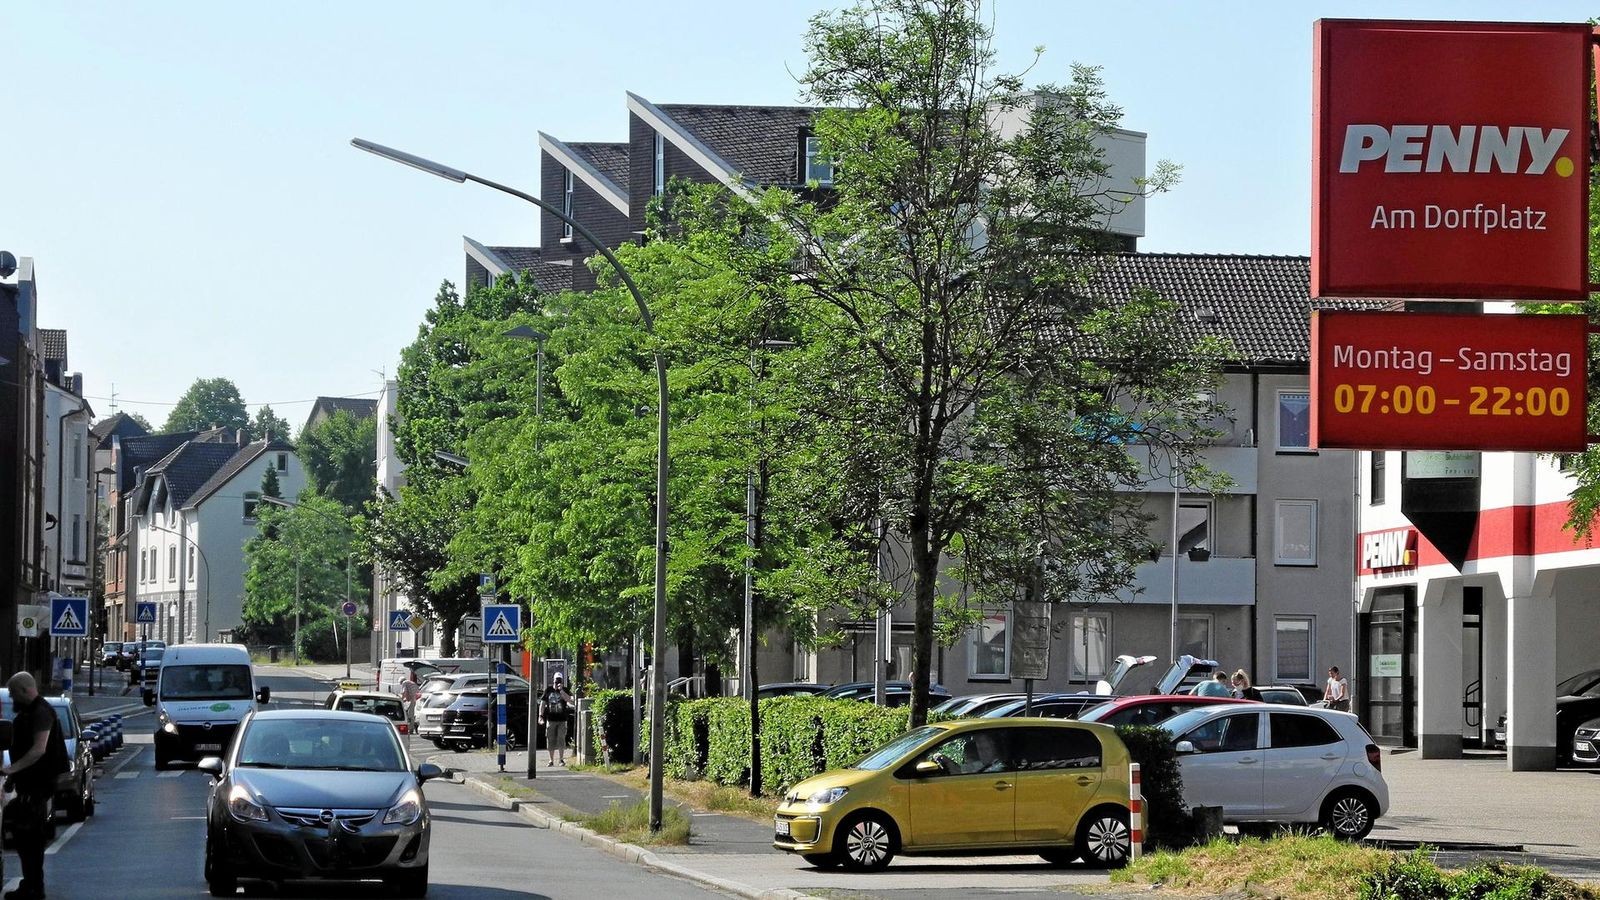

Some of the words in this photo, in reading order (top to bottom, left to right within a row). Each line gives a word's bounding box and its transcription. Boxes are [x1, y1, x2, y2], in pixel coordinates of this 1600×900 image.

[1370, 205, 1415, 230] Am
[1424, 203, 1547, 235] Dorfplatz
[1333, 344, 1432, 375] Montag
[1458, 347, 1571, 377] Samstag
[1334, 383, 1436, 415] 07:00
[1469, 386, 1570, 417] 22:00
